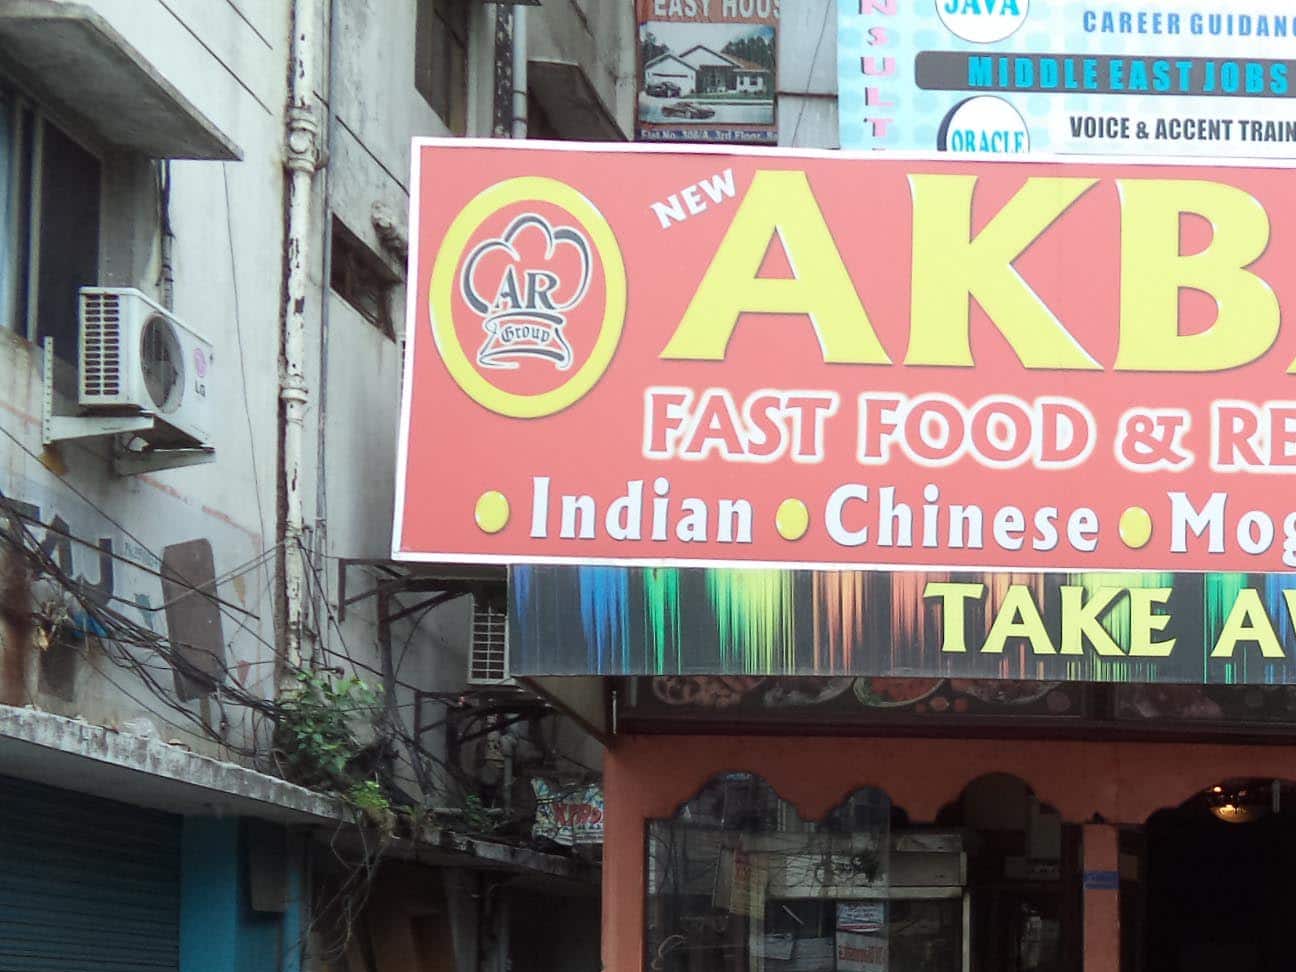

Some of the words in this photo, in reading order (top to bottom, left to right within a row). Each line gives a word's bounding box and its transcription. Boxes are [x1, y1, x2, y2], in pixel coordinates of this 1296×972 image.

[1083, 11, 1180, 34] CAREER
[968, 56, 1098, 90] MIDDLE
[1108, 60, 1193, 91] EAST
[1203, 62, 1289, 94] JOBS
[951, 130, 1025, 153] ORACLE
[1070, 116, 1130, 139] VOICE
[1136, 121, 1149, 139] &
[1155, 118, 1233, 141] ACCENT
[649, 168, 737, 229] NEW
[494, 266, 558, 311] AR
[501, 323, 552, 344] Group
[642, 387, 839, 461] FAST
[857, 393, 1095, 470] FOOD
[1114, 408, 1194, 472] &
[530, 475, 753, 544] Indian
[824, 482, 1098, 552] Chinese
[922, 582, 1177, 658] TAKE
